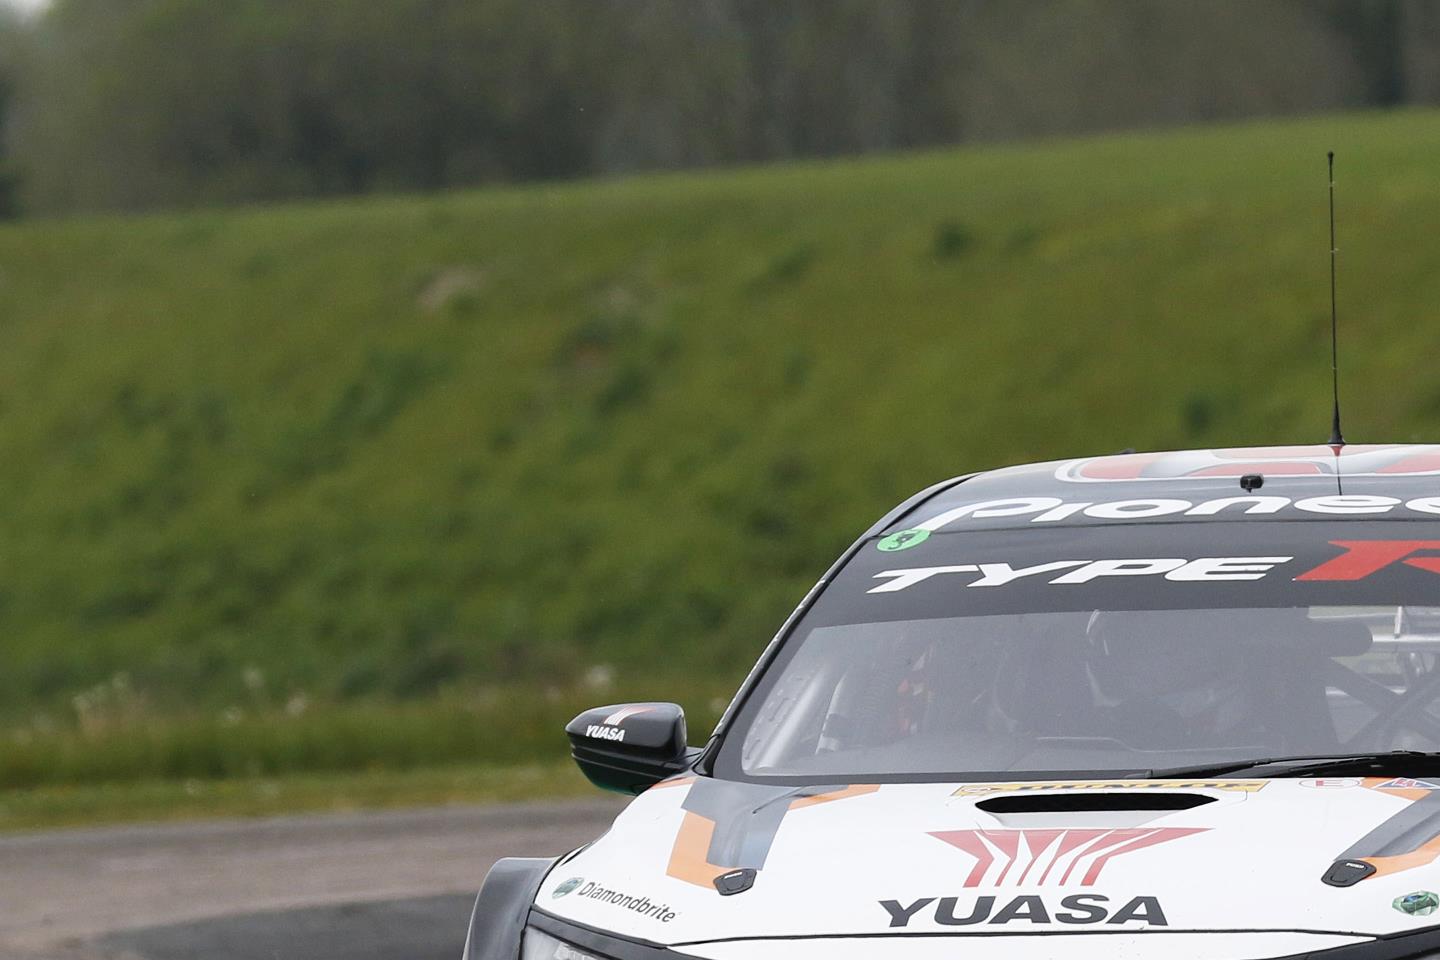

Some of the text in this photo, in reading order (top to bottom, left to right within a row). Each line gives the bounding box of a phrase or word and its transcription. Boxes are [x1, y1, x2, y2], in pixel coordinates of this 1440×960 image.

[866, 555, 1294, 594] TYPE
[585, 725, 626, 742] YUASA
[577, 881, 676, 923] Diamondbrite
[878, 894, 1168, 928] YUASA
